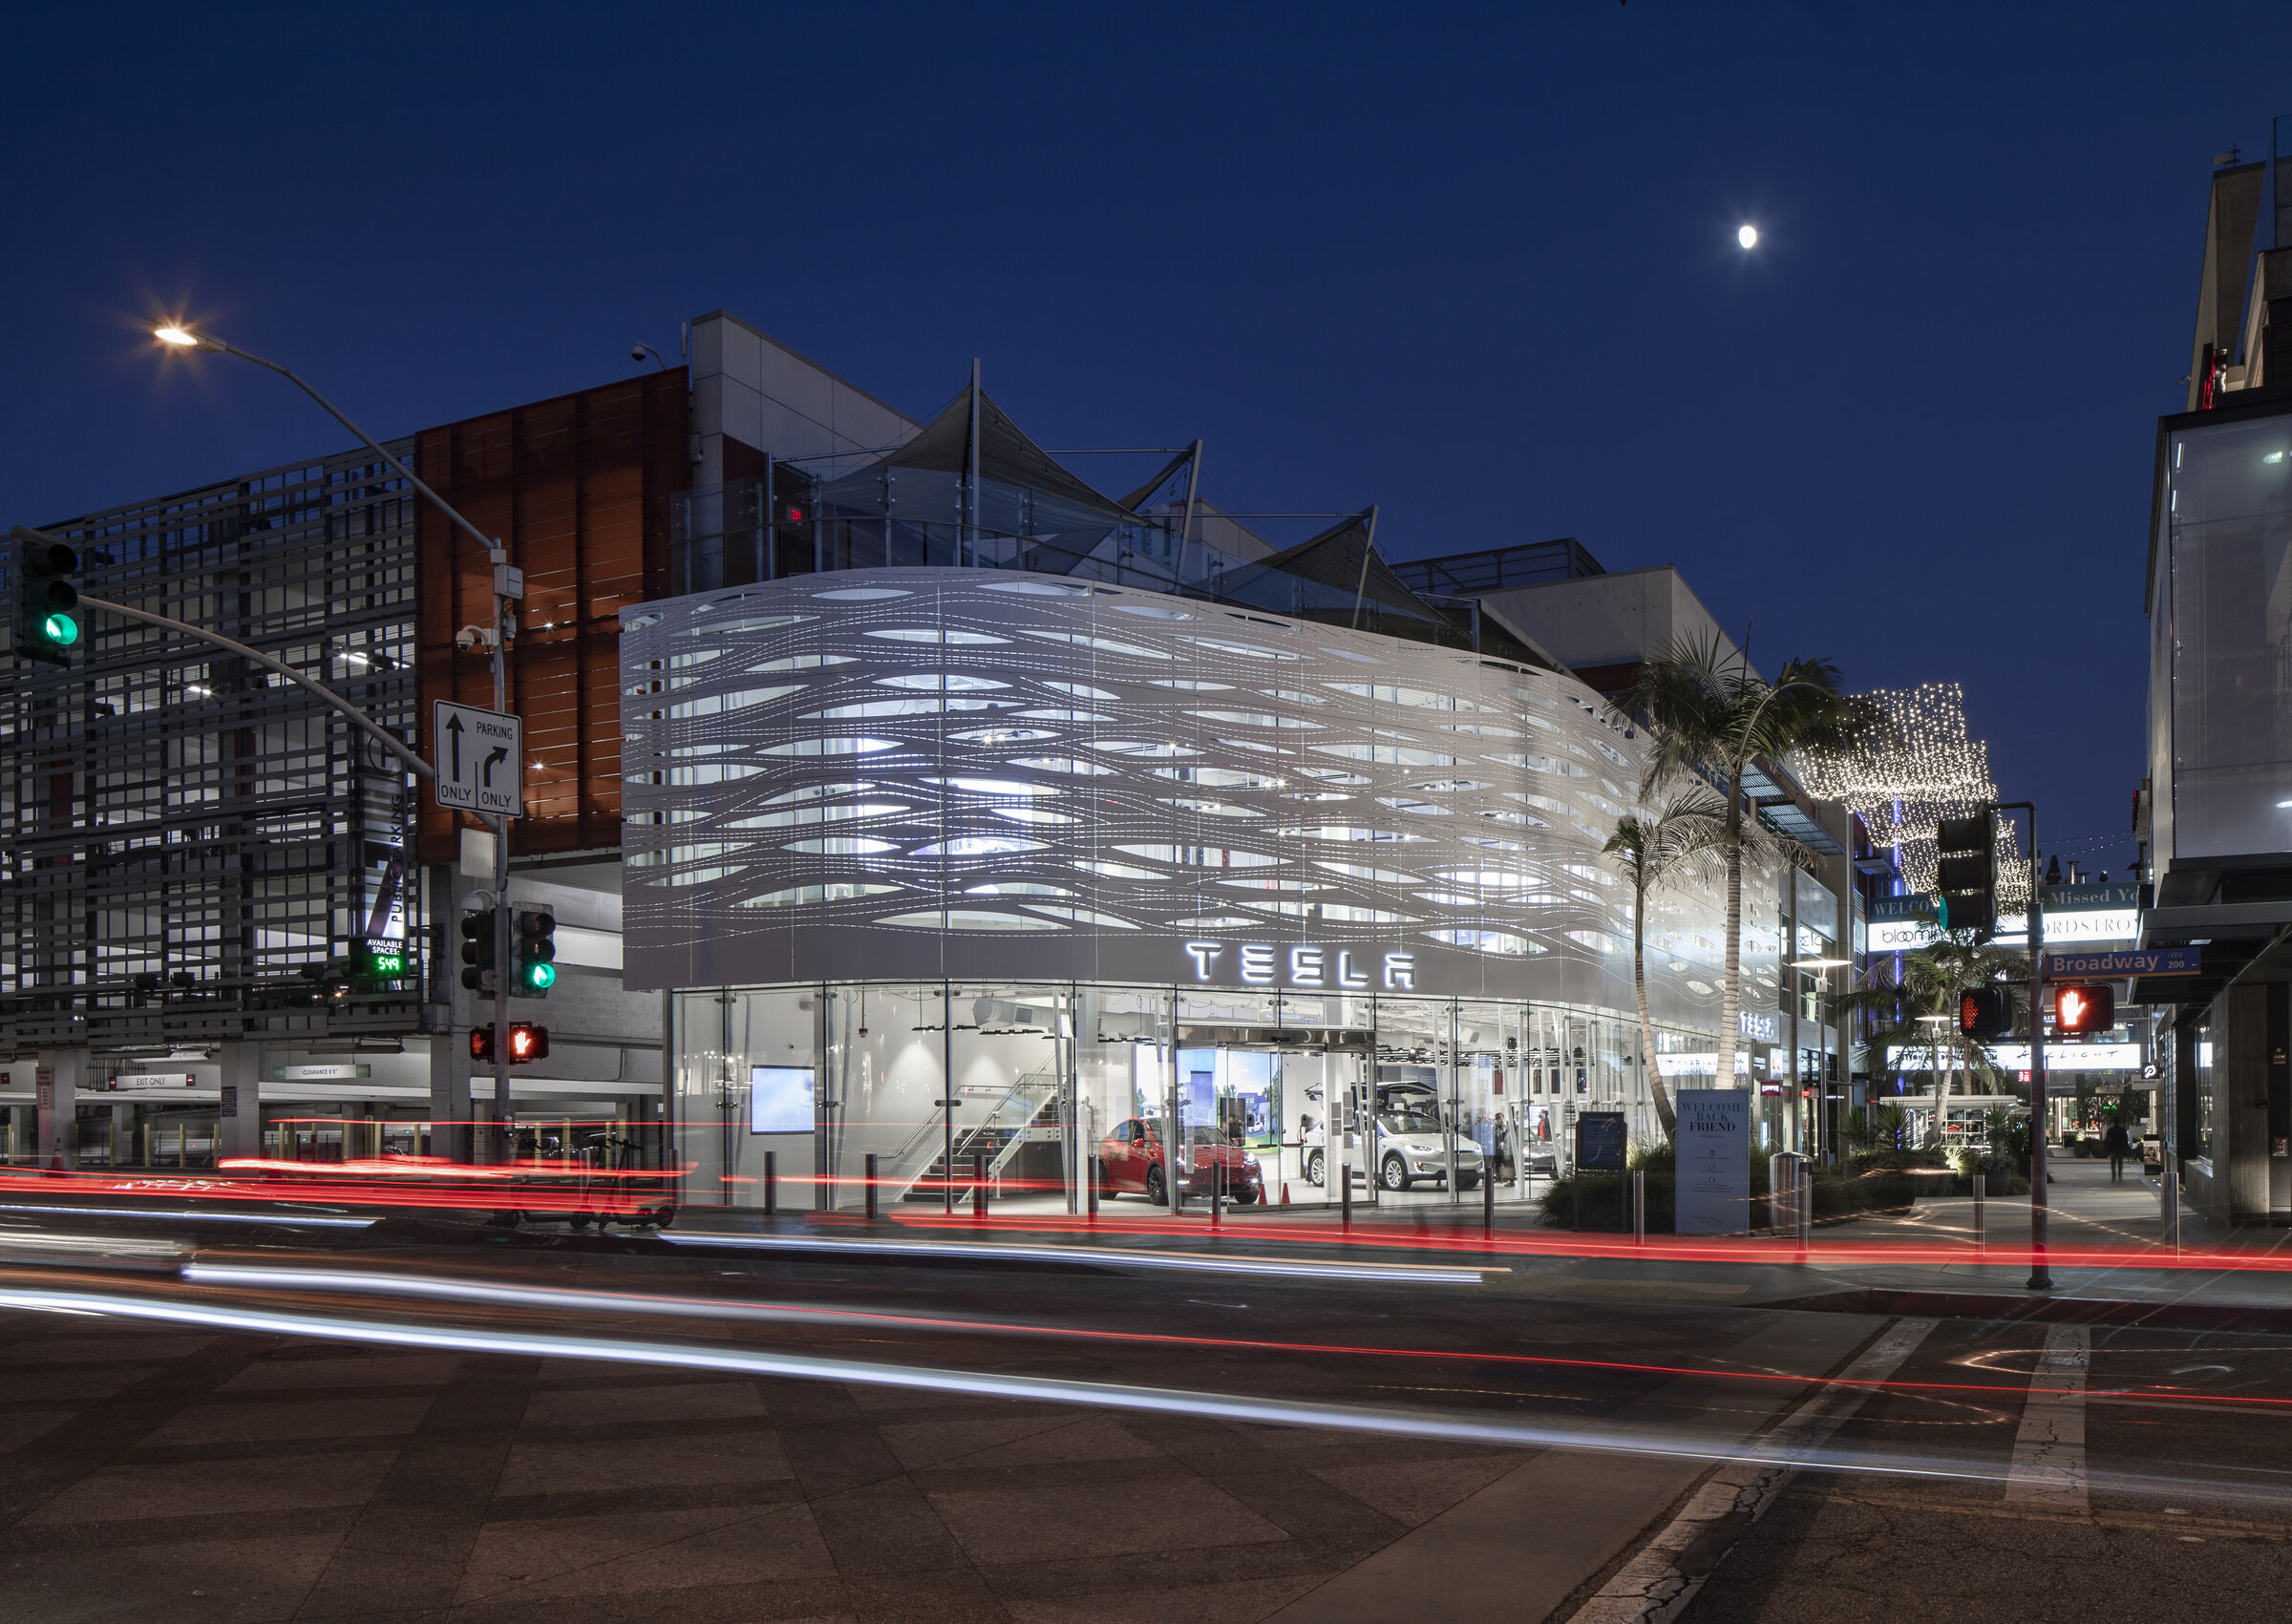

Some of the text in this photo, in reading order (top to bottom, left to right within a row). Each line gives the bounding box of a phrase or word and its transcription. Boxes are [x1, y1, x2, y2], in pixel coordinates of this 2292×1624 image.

[476, 721, 514, 741] PARKING
[440, 784, 472, 802] ONLY
[481, 791, 512, 808] ONLY
[2050, 888, 2111, 905] Missed
[367, 939, 403, 949] AVAILABLE
[371, 946, 400, 956] SPACES:
[377, 957, 399, 970] 549
[1187, 943, 1416, 988] TESLA
[2053, 953, 2159, 972] Broadway
[2168, 960, 2185, 969] 200
[149, 1077, 166, 1086] ONLY
[1682, 1102, 1745, 1112] WELCOME
[1696, 1112, 1729, 1122] BACK
[1689, 1122, 1736, 1131] FRIEND
